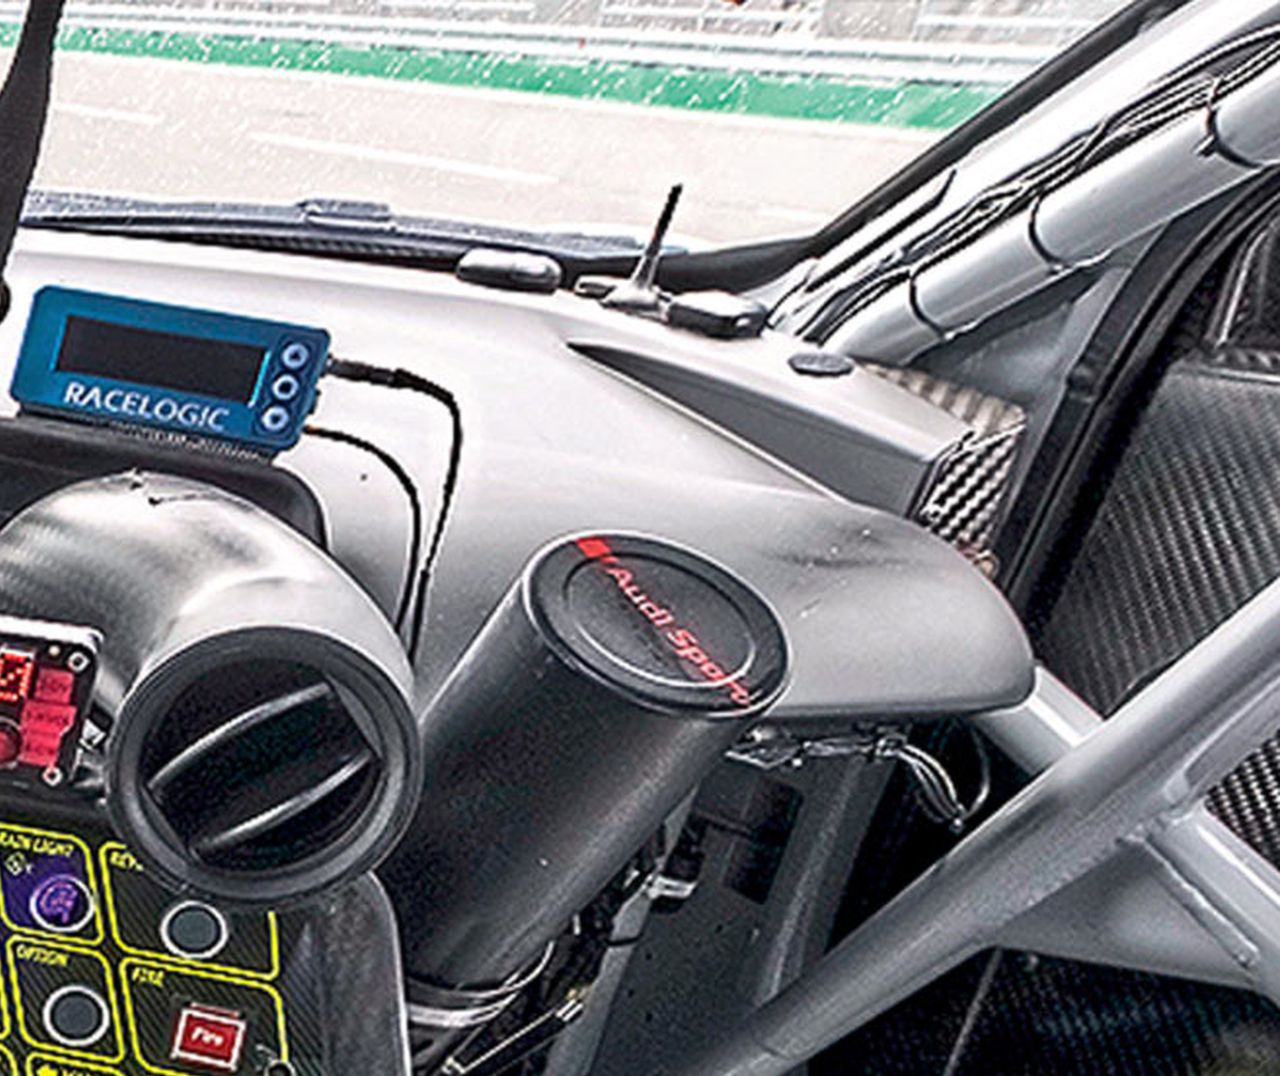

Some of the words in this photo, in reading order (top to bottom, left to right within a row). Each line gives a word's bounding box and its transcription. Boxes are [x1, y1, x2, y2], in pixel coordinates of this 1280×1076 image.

[63, 380, 231, 432] RACELOGIC
[605, 566, 674, 628] Audi
[666, 628, 752, 708] Sport
[190, 1026, 225, 1048] Fire
